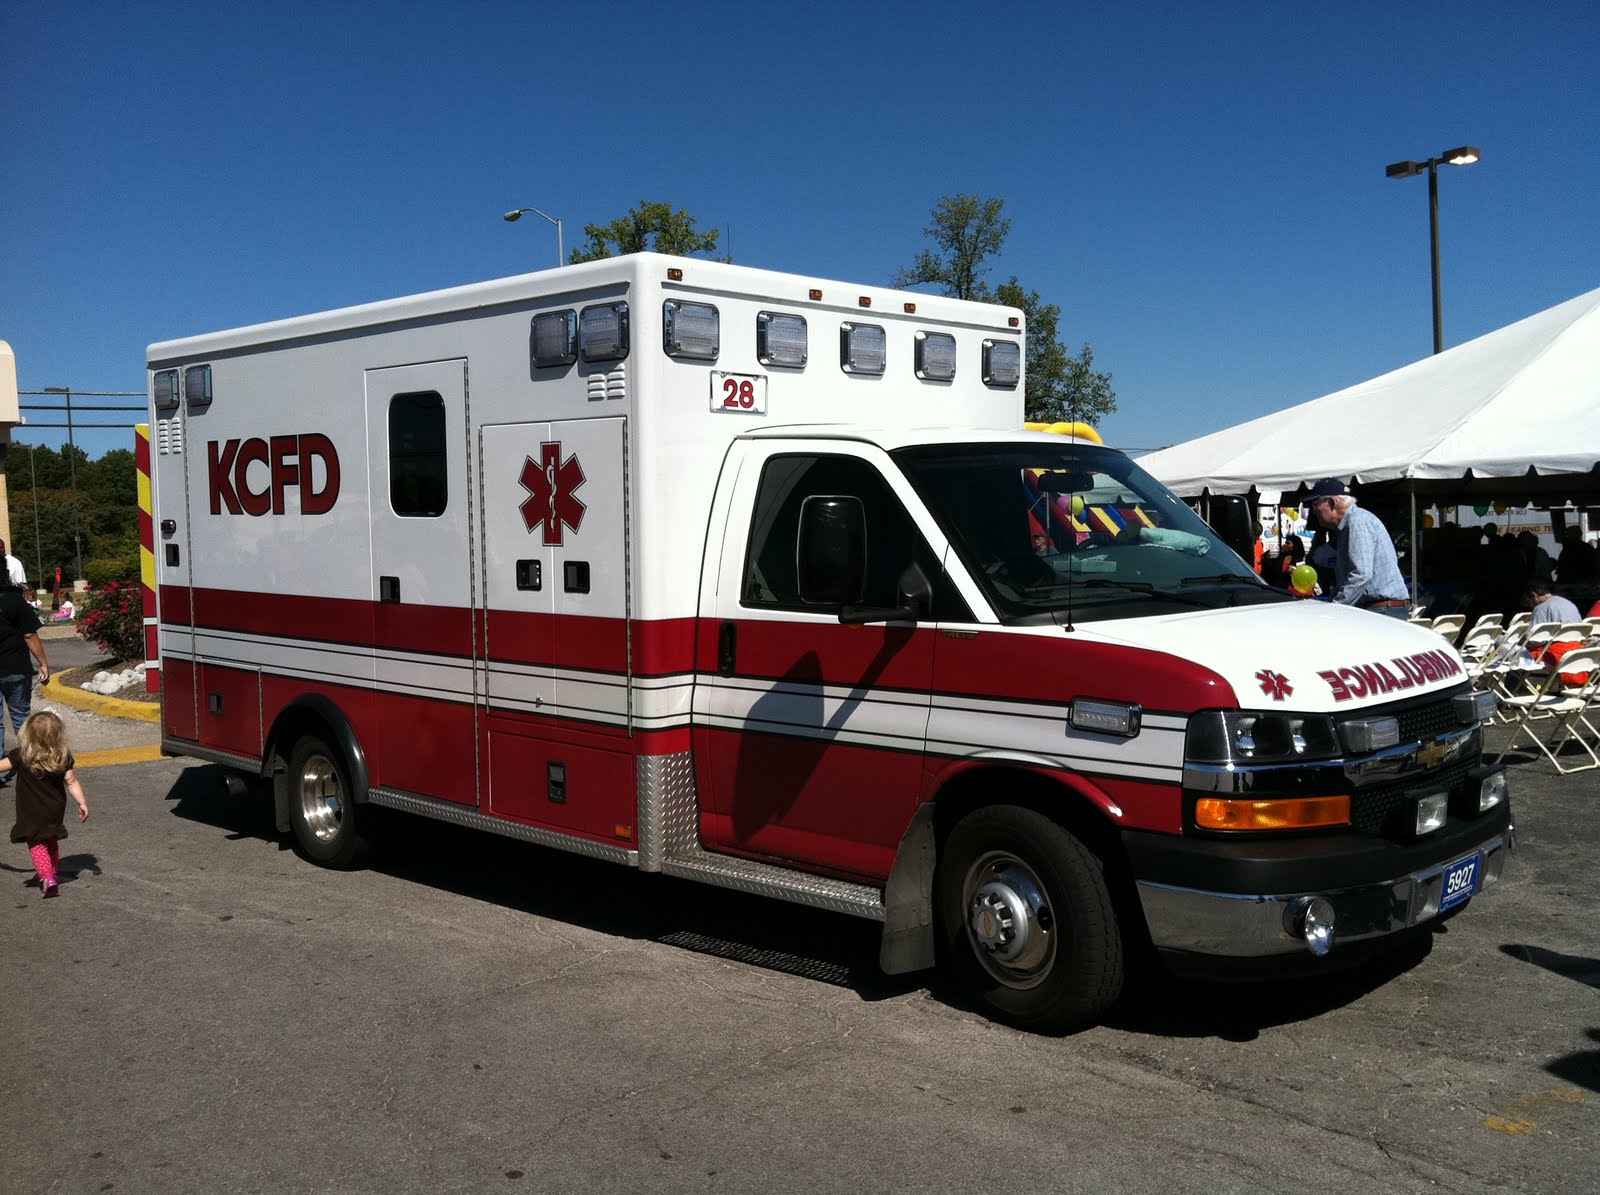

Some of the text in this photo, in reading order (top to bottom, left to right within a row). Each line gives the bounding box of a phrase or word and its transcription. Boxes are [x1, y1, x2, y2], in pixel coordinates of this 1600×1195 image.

[723, 378, 754, 409] 28
[207, 433, 341, 517] KCFD
[1447, 863, 1475, 894] 5927
